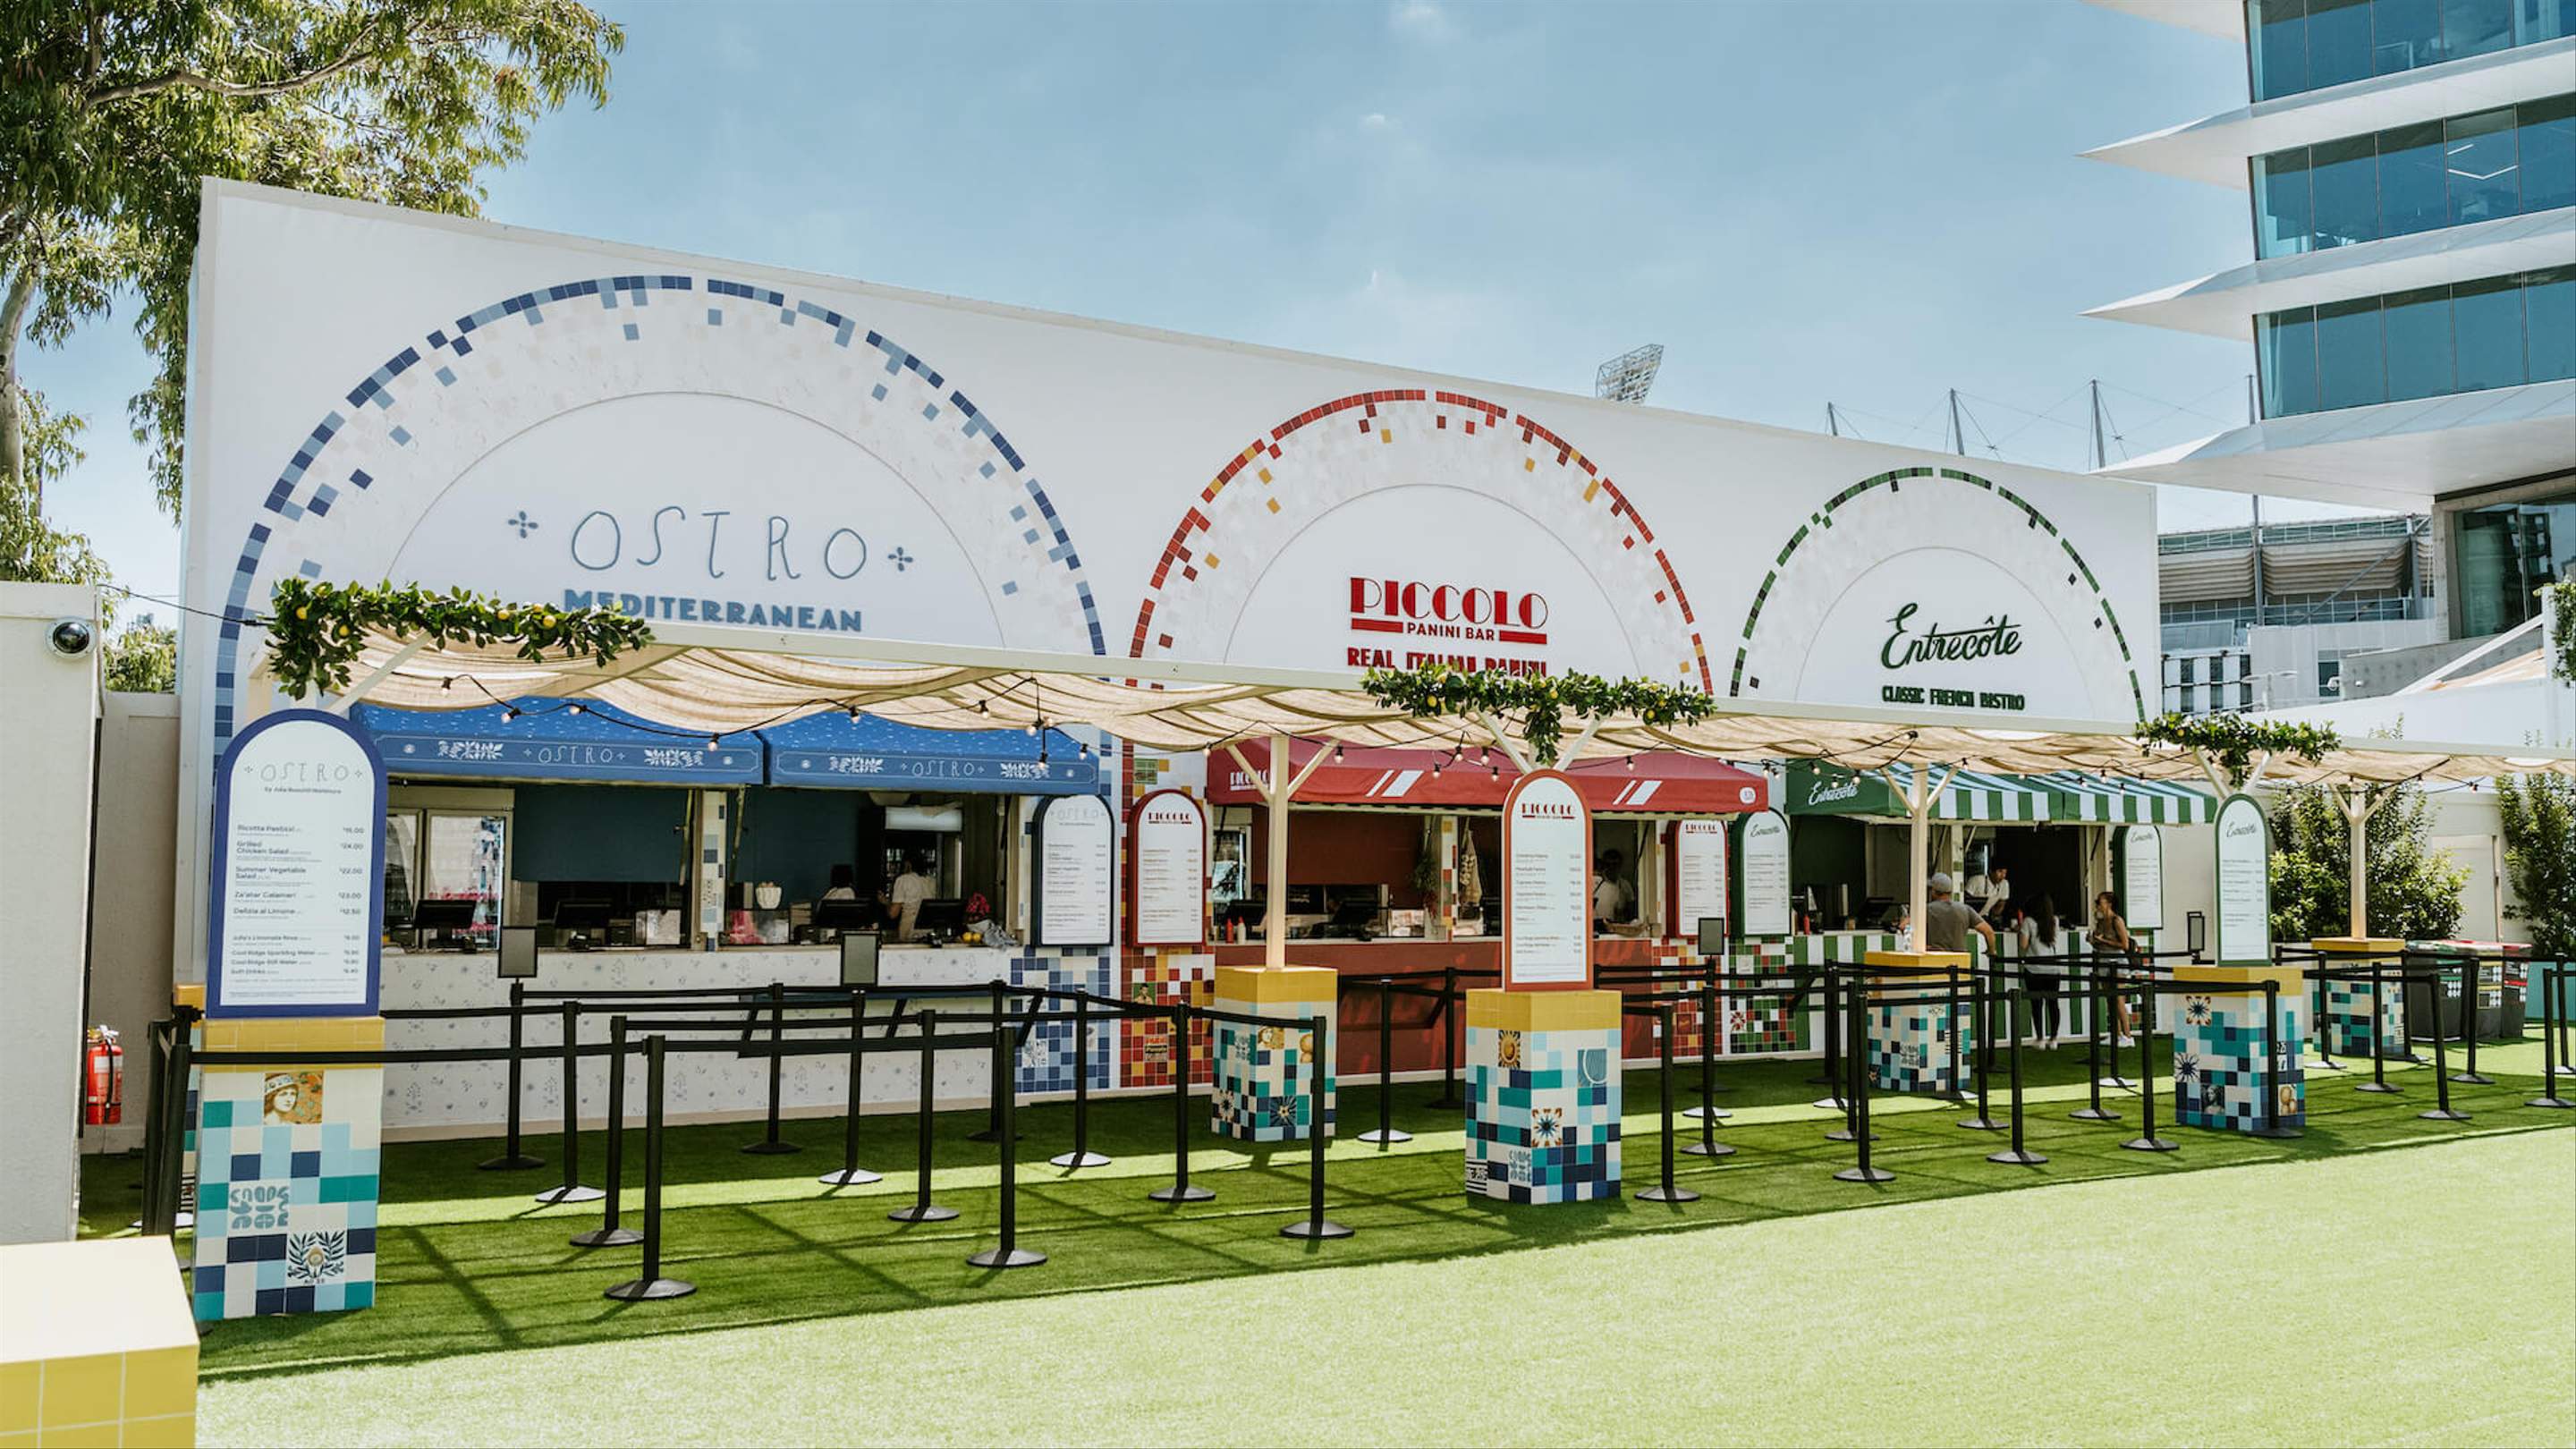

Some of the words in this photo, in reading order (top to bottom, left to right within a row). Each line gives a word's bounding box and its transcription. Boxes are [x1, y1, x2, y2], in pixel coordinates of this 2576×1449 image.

[571, 505, 868, 581] OSTRO
[564, 589, 862, 632] MEDITERRANEAN
[1350, 577, 1548, 629] PICCOLO
[1407, 623, 1461, 639] PANINI
[1465, 627, 1495, 641] BAR
[1881, 603, 2022, 669] Entrecôte
[1347, 647, 1396, 669] REAL
[1882, 685, 1925, 704] CLASSIC
[1929, 689, 1975, 708] FRENCH
[1979, 692, 2025, 710] BISTRO
[538, 745, 613, 764] OSTRO
[260, 762, 350, 783] OSTRO
[912, 759, 975, 777] OSTRO
